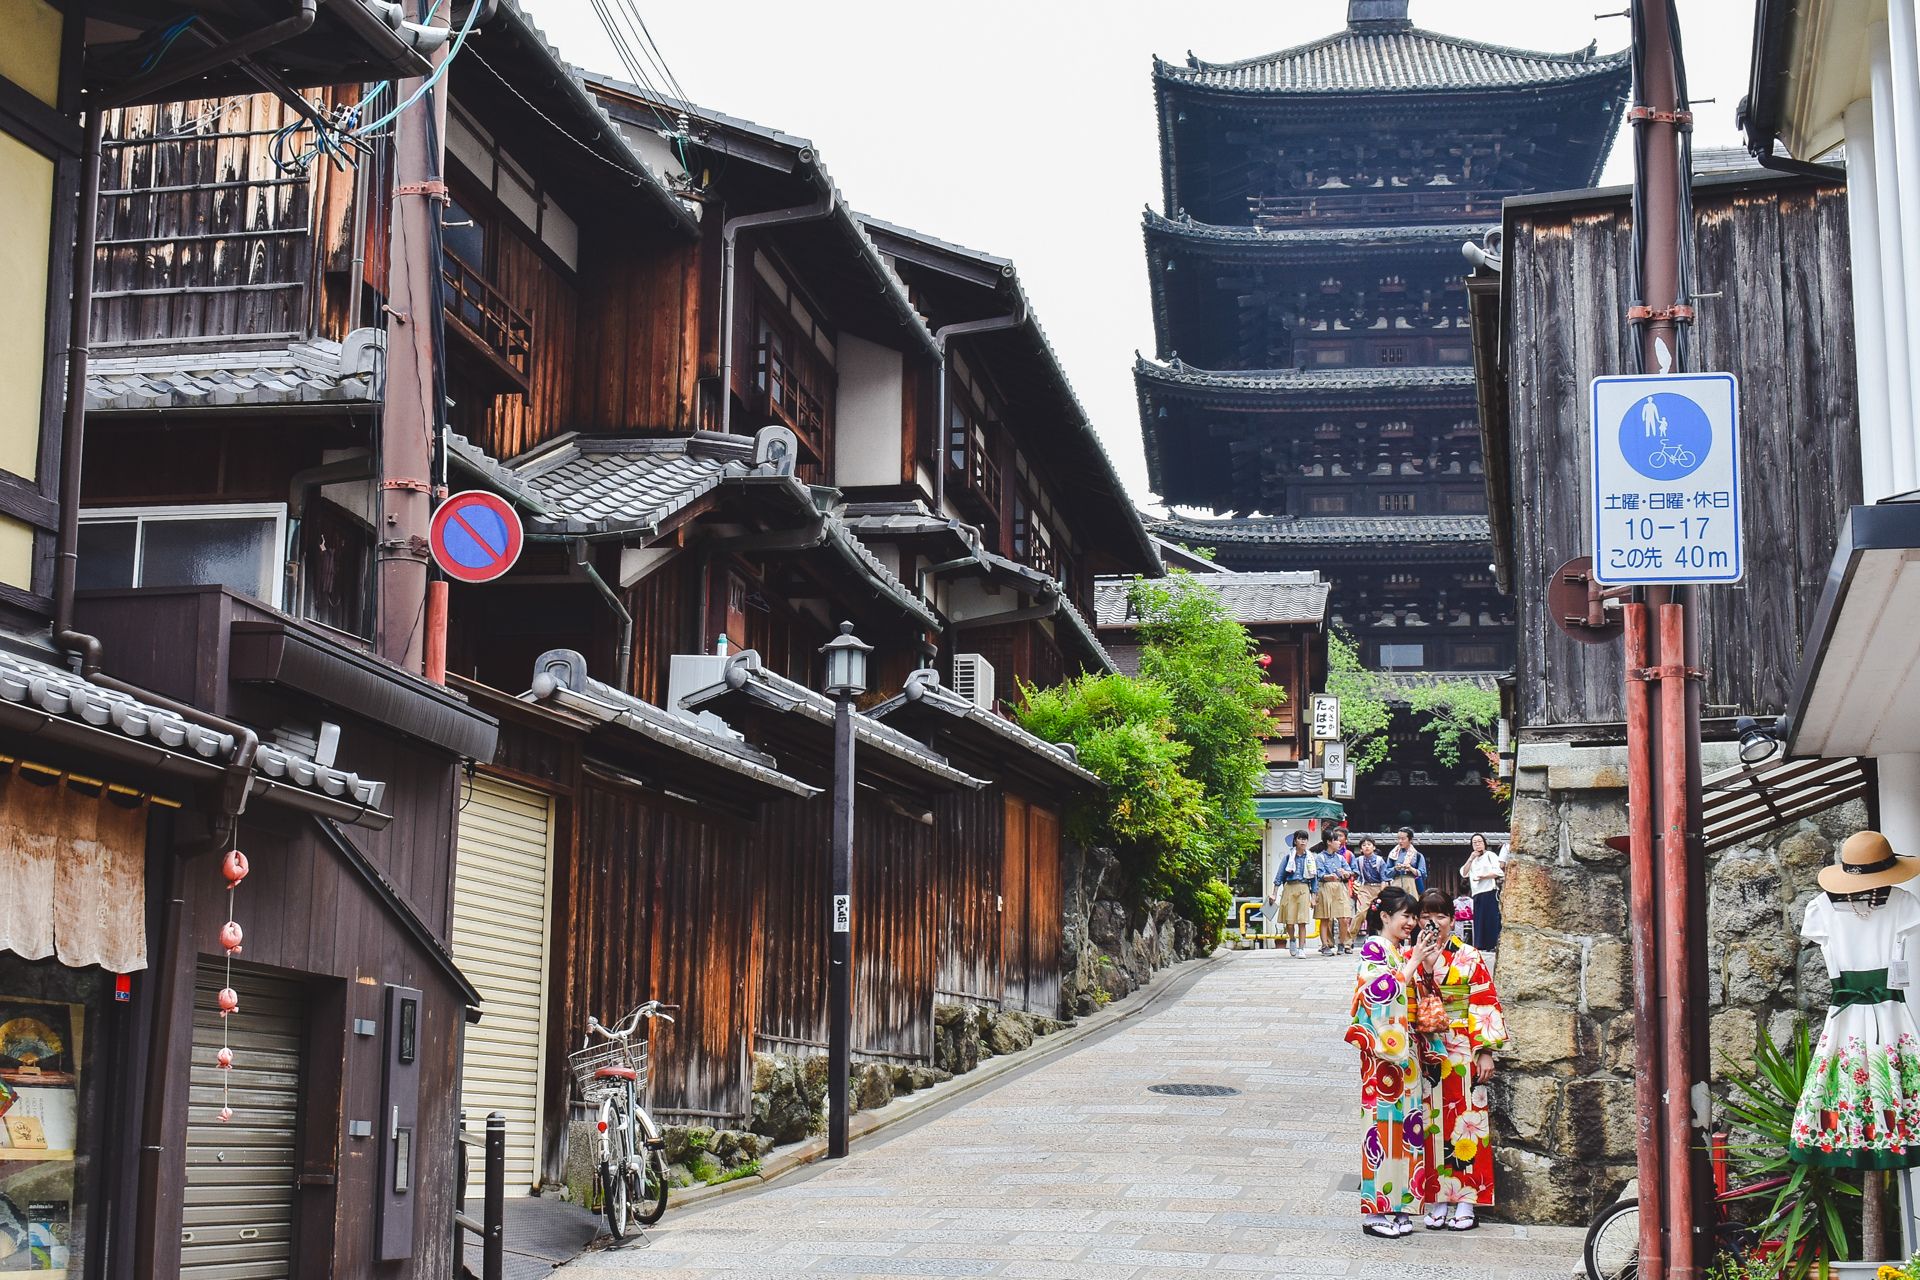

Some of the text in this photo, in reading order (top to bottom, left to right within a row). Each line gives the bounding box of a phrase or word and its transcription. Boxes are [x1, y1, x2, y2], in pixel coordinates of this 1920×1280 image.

[1604, 491, 1730, 510] 土曜・日曜・休日
[1610, 545, 1728, 568] この先 40m
[1316, 699, 1327, 735] たばこ
